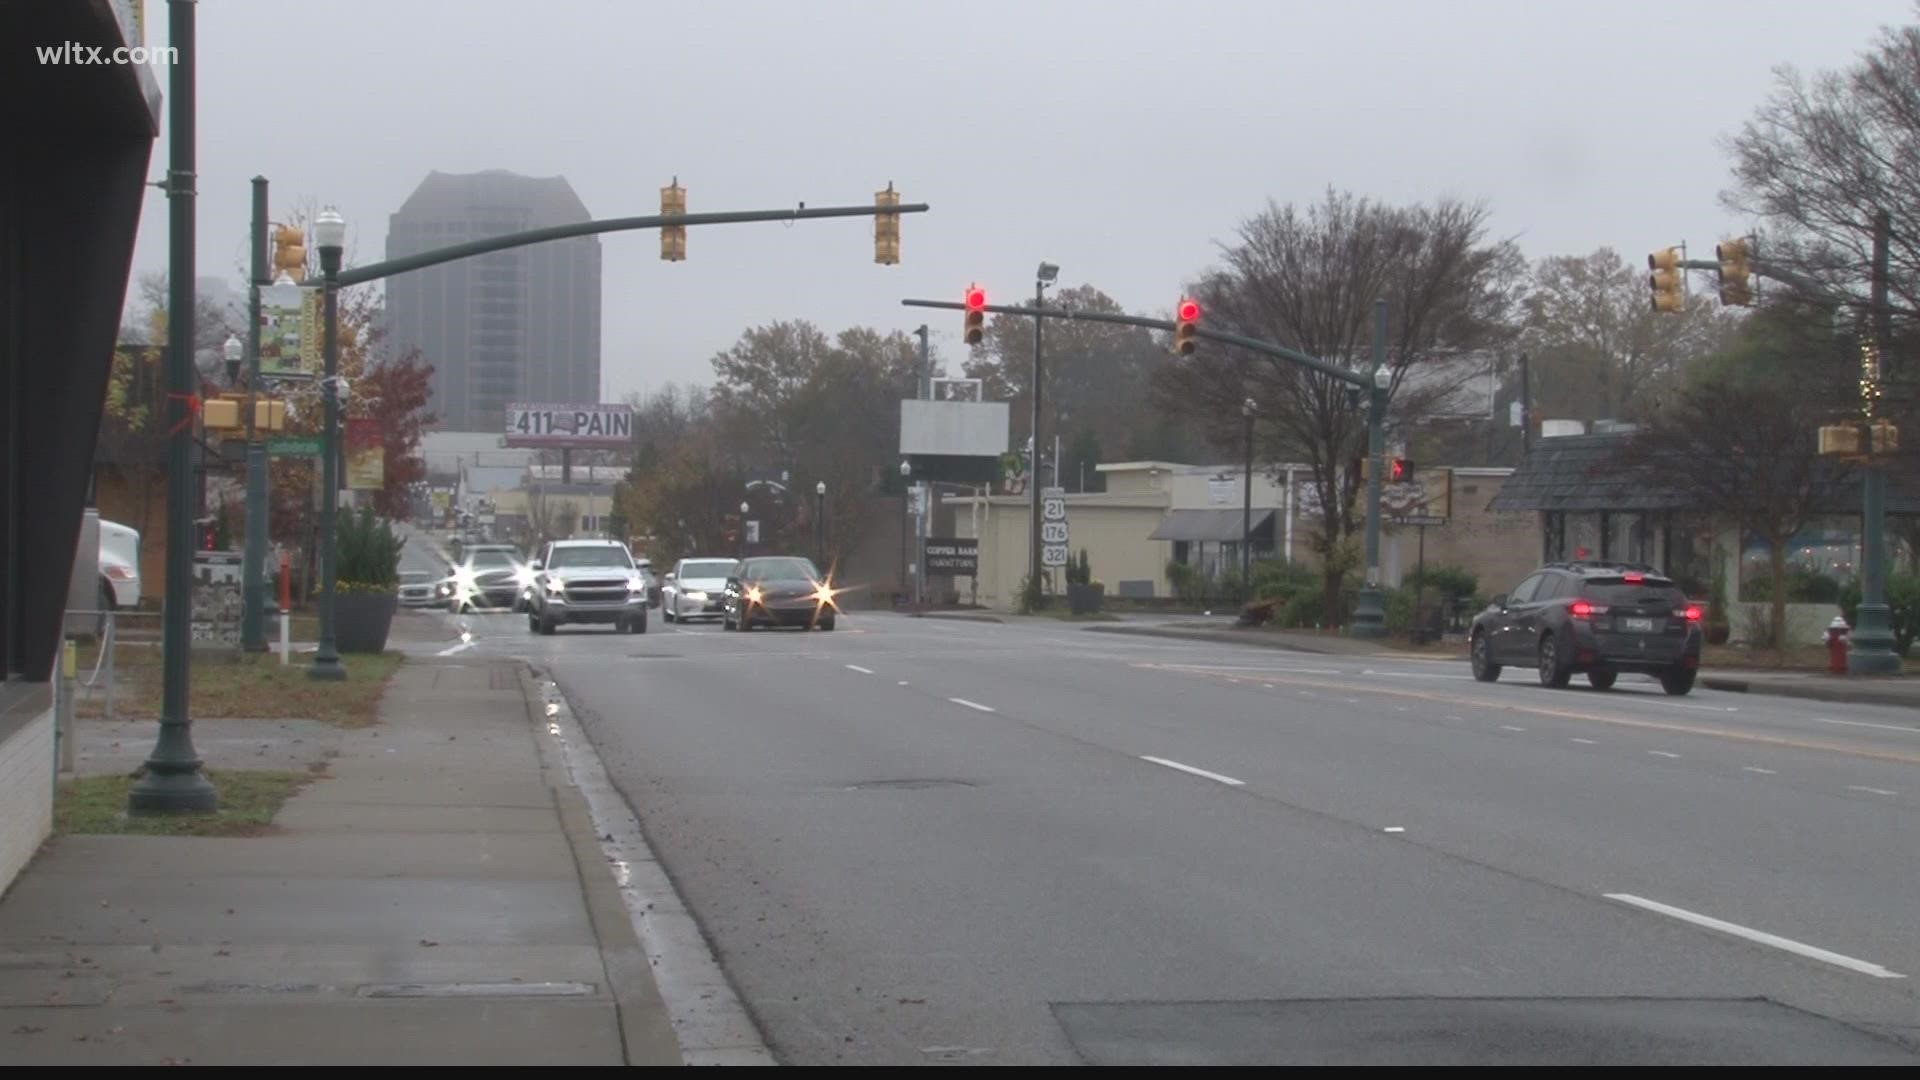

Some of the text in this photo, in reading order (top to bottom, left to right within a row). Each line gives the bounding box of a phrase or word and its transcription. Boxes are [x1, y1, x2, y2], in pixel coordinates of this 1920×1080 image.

[516, 411, 552, 435] 411
[573, 412, 629, 436] PAIN
[1048, 503, 1062, 516] 21
[1046, 526, 1065, 539] 176
[1047, 549, 1065, 562] 321
